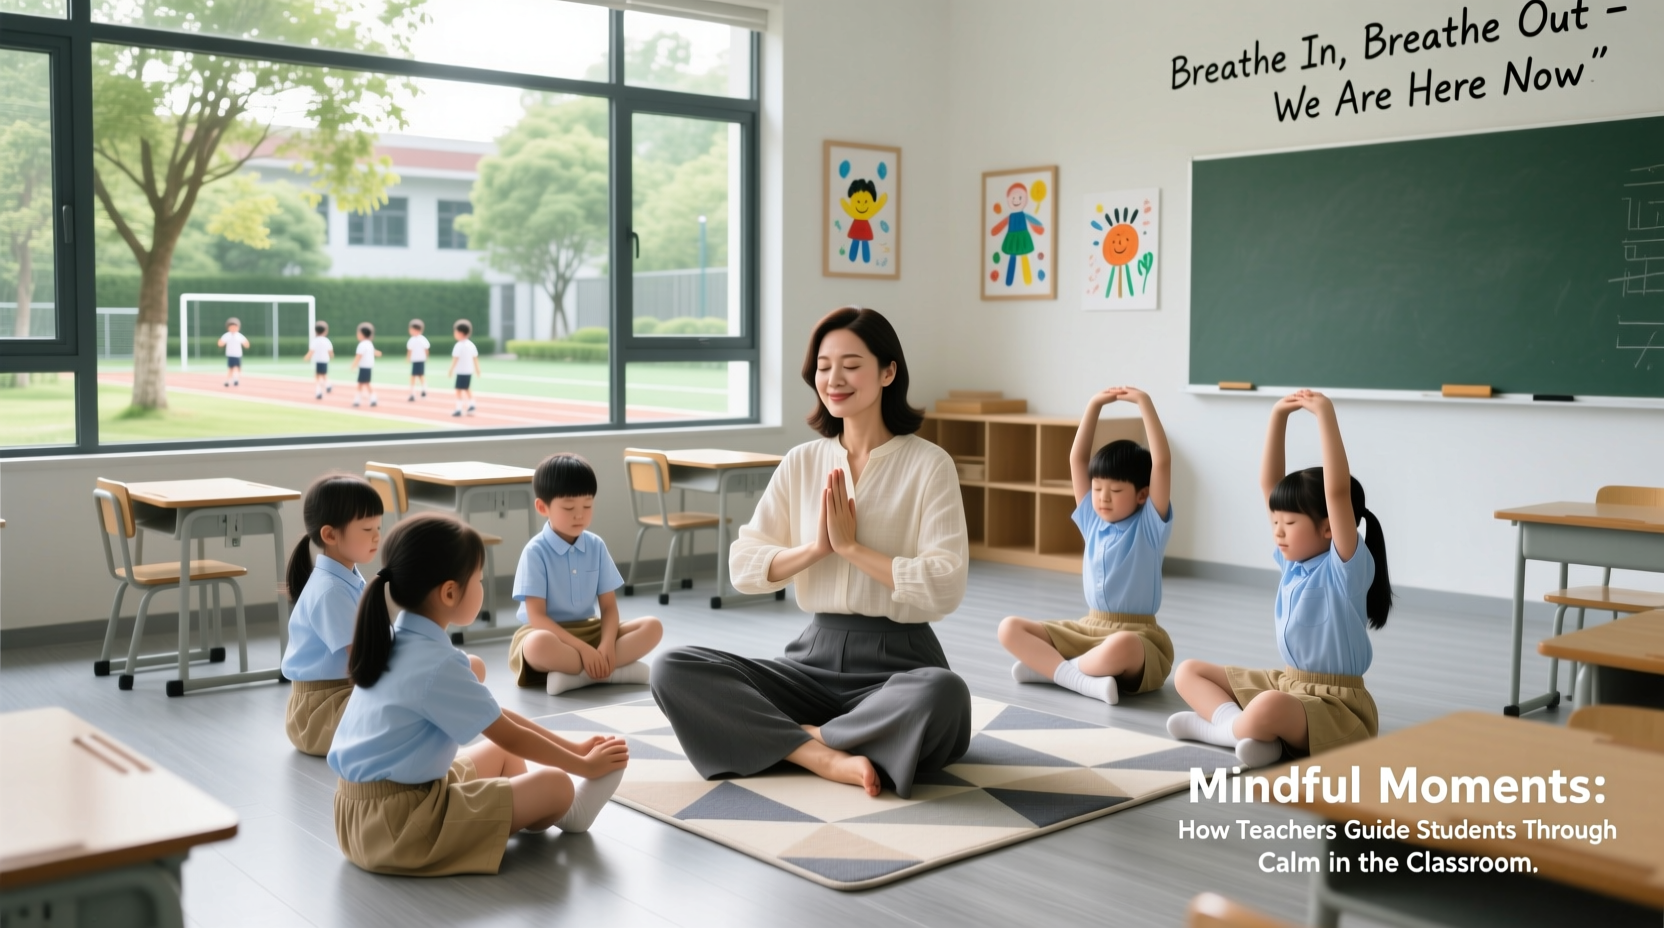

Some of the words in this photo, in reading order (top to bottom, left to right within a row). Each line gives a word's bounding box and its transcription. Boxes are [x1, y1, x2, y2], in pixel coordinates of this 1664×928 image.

[1171, 39, 1287, 91] Breathe
[1300, 33, 1347, 71] In,
[1364, 6, 1500, 60] Breathe
[1518, 0, 1590, 38] Out
[1273, 84, 1320, 123] We
[1334, 79, 1392, 117] Are
[1408, 68, 1487, 108] Here
